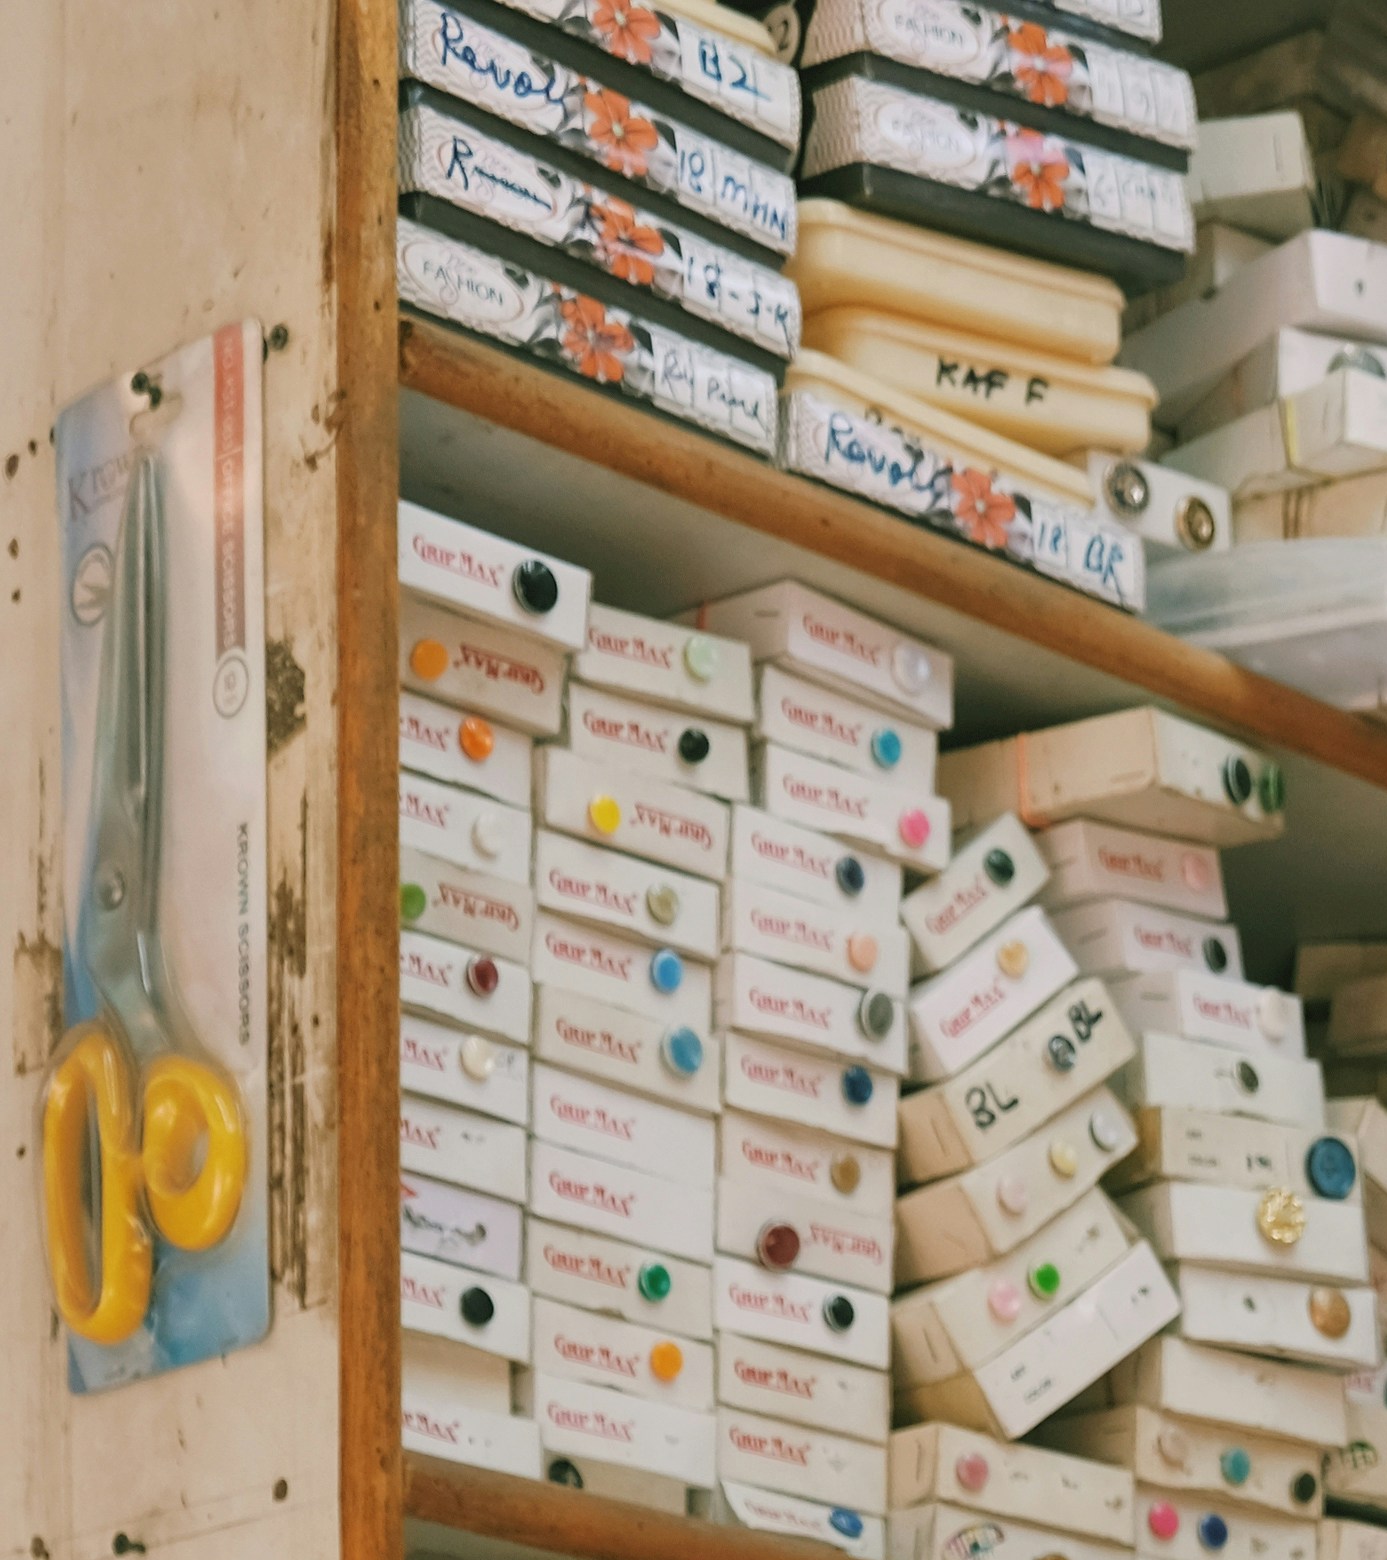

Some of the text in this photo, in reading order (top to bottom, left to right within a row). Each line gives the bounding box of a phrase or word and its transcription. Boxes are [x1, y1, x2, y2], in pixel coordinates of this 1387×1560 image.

[422, 260, 503, 307] FASHION
[412, 533, 456, 570] GRIP
[589, 626, 630, 656] GRIP
[803, 614, 842, 645] GRIP
[583, 710, 624, 739] GRIP
[782, 698, 821, 728] GRIP
[783, 774, 823, 803] GRIP
[549, 869, 591, 897] GRIP
[545, 931, 588, 961] GRIP
[556, 1018, 598, 1048] GRIP
[550, 1096, 592, 1125] GRIP
[965, 1084, 1020, 1130] BL
[549, 1172, 592, 1201] GRIP
[543, 1246, 586, 1277] GRIP
[554, 1335, 597, 1364] GRIP
